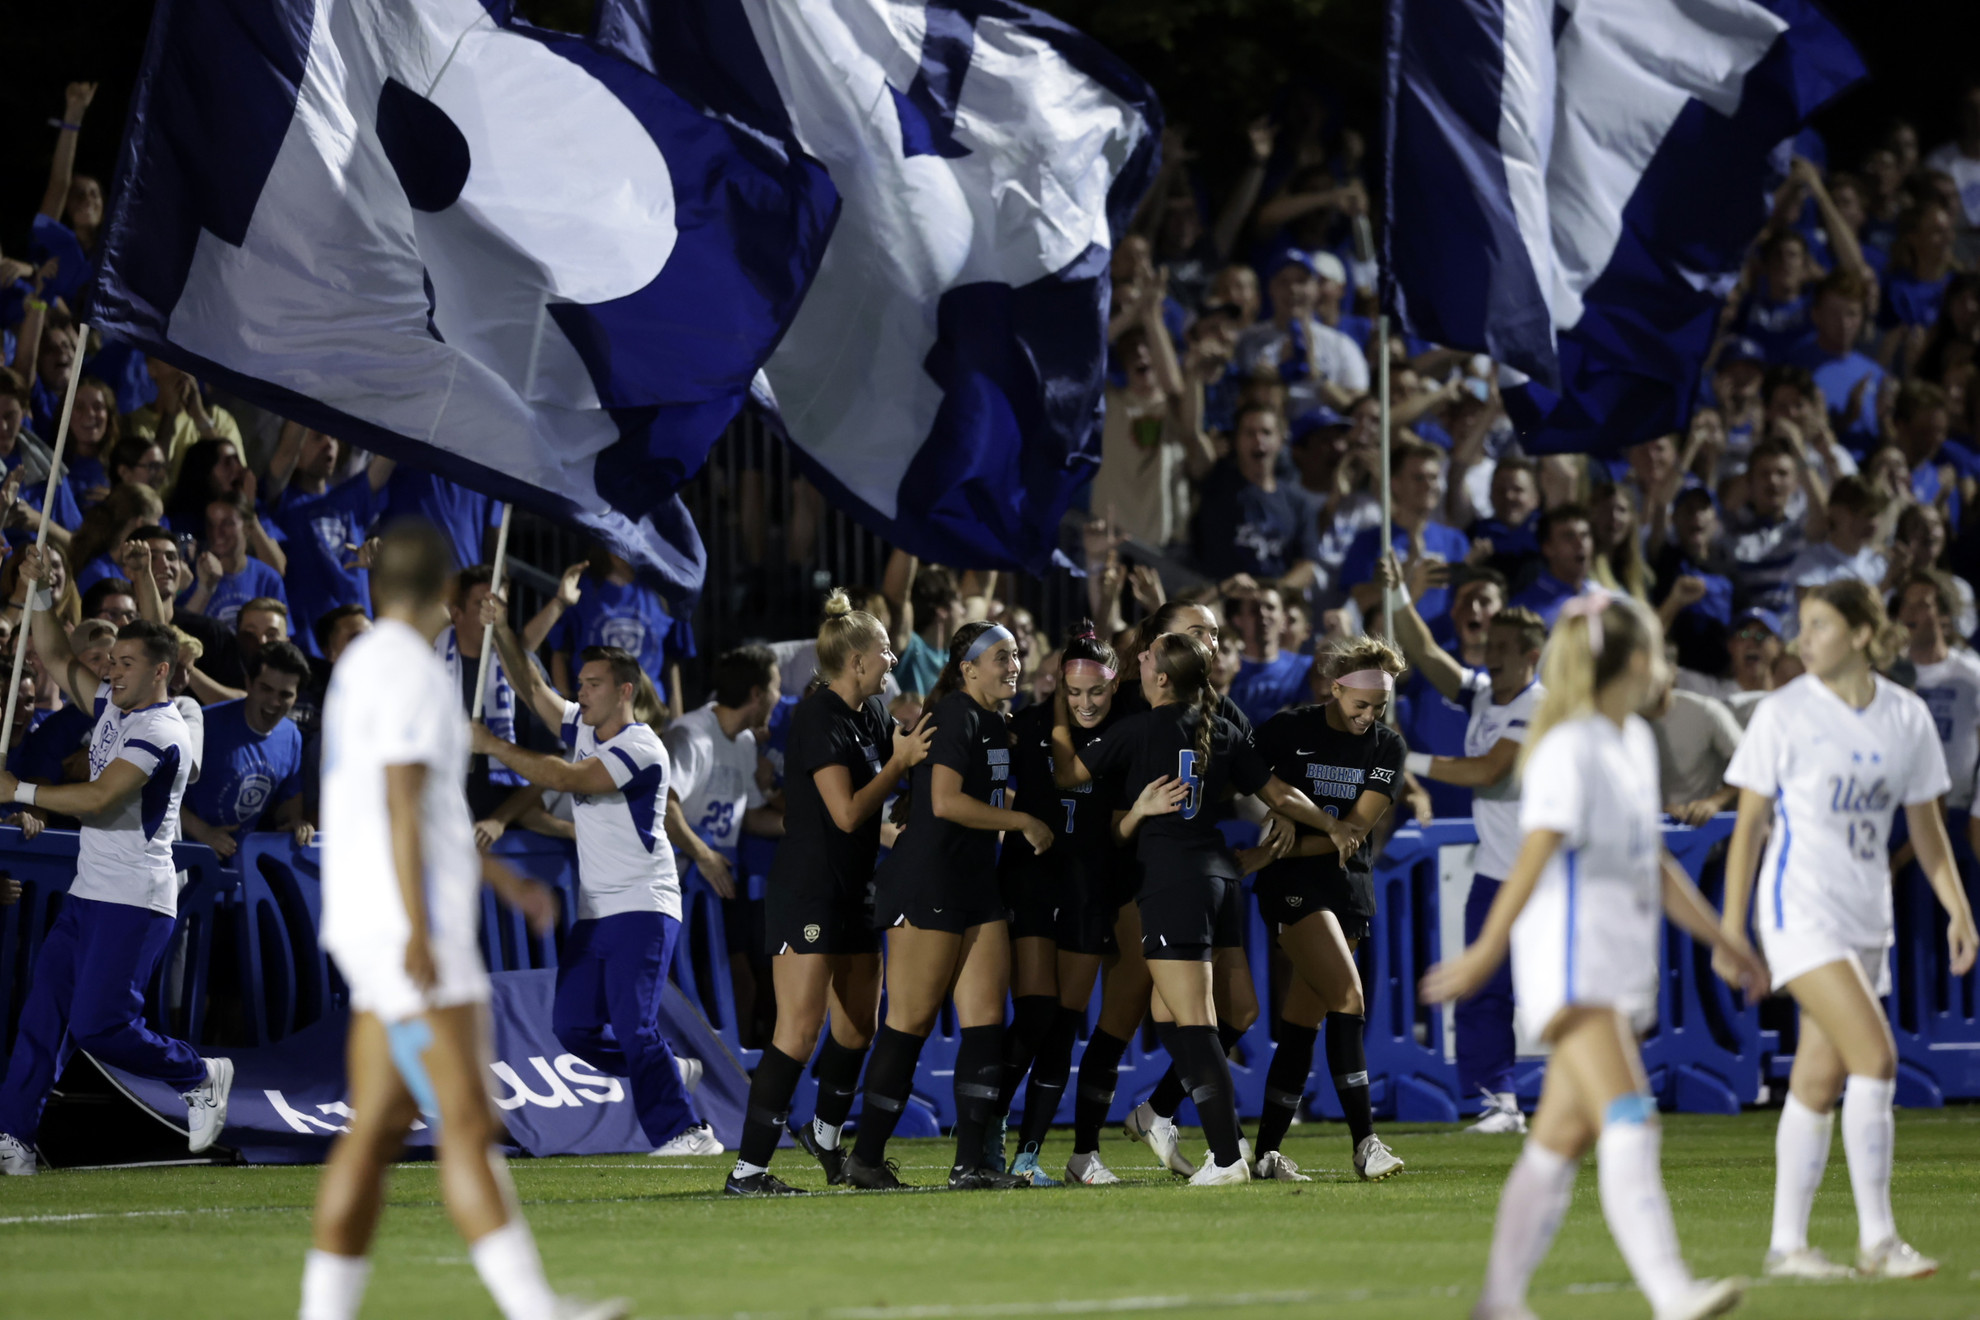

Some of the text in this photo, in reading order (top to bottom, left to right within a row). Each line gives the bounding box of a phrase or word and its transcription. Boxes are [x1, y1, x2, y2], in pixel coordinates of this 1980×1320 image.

[1305, 762, 1366, 784] BRIGHAM
[1313, 780, 1357, 800] YOUNG
[701, 800, 734, 839] 23
[1060, 799, 1077, 833] 7
